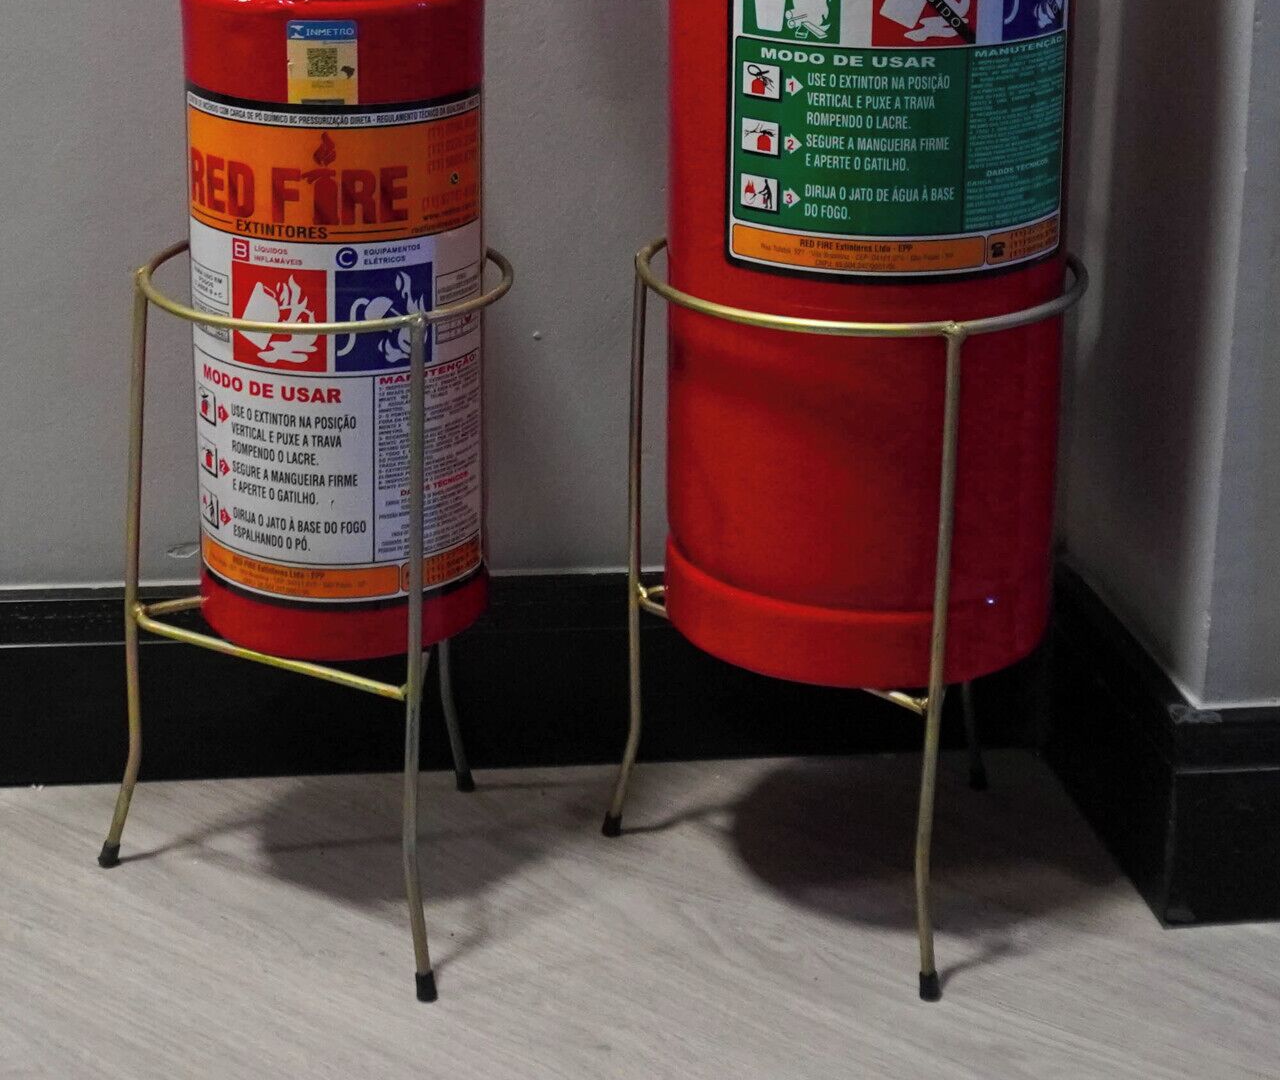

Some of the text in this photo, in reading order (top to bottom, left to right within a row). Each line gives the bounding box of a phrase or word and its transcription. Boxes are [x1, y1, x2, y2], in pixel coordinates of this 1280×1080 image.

[306, 27, 354, 37] INMETRO
[974, 35, 1063, 58] MANUTENÇÃO
[761, 47, 936, 68] MODO DE USAR
[807, 72, 950, 92] USE O EXTINTOR NA POSIÇÃO
[807, 92, 936, 110] VERTICAL E PUXE A TRAVA
[806, 111, 912, 130] ROMPENDO O LACRE.
[806, 133, 950, 152] SEGURE A MANGUEIRA FIRME
[805, 153, 910, 171] E APERTE O GATILHO.
[191, 146, 255, 218] RED
[272, 165, 408, 225] FIRE
[805, 183, 836, 199] DIRIJA
[839, 186, 846, 200] O
[848, 187, 873, 201] JATO
[876, 188, 889, 201] DE
[893, 185, 919, 202] ÁGUA
[931, 187, 955, 200] BASE
[804, 203, 851, 220] DO FOGO.
[236, 219, 328, 239] EXTINTORES
[234, 242, 248, 258] B
[254, 245, 288, 255] LÍQUIDOS
[363, 244, 421, 256] EQUIPAMENTOS
[800, 238, 814, 248] RED
[817, 240, 833, 250] FIRE
[254, 256, 303, 266] INFLAMÁVEIS
[339, 250, 353, 266] C
[363, 255, 406, 265] ELÉTRICOS
[379, 352, 475, 385] MATENÇÃO
[203, 364, 342, 403] MODO DE USAR
[231, 403, 357, 432] USE O EXTINTOR NA POSIÇÃO
[231, 422, 342, 448] VERTICAL E PUXE A TRAVA
[231, 440, 319, 466] ROMPENDO O LACRE.
[232, 460, 358, 487] SEGURE A MANGUEIRA FIRME
[232, 478, 319, 505] E APERTE O GATILHO.
[233, 506, 367, 534] DIRIJA O JATO À BASE DO FOGO
[233, 524, 311, 552] ESPALHANDO O PÓ.
